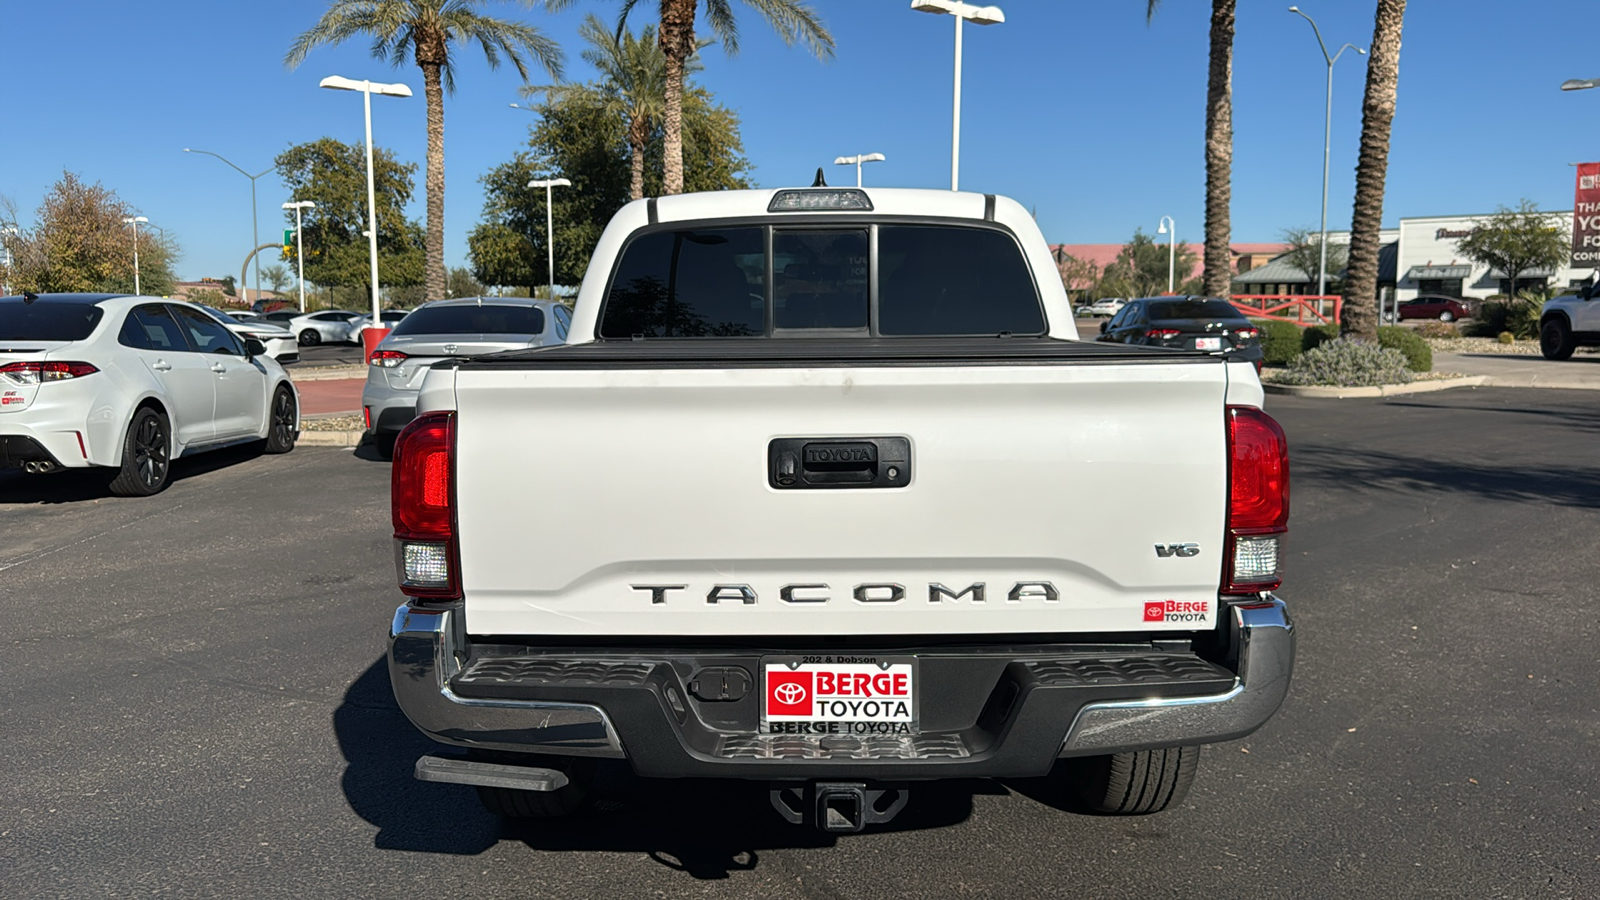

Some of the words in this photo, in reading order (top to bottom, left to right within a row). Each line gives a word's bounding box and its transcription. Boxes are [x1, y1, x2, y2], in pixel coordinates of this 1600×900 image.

[809, 448, 871, 461] TOYOTA
[1154, 542, 1200, 558] V6
[628, 581, 1061, 605] TACOMA
[1165, 600, 1208, 613] BERGE
[1165, 613, 1206, 622] TOYOTA
[802, 656, 822, 664] 202
[825, 656, 833, 664] &
[837, 656, 877, 664] Dobson
[816, 671, 908, 698] BERGE
[816, 700, 910, 717] TOYOTA
[769, 721, 840, 734] BERGE
[846, 721, 910, 734] TOYOTA
